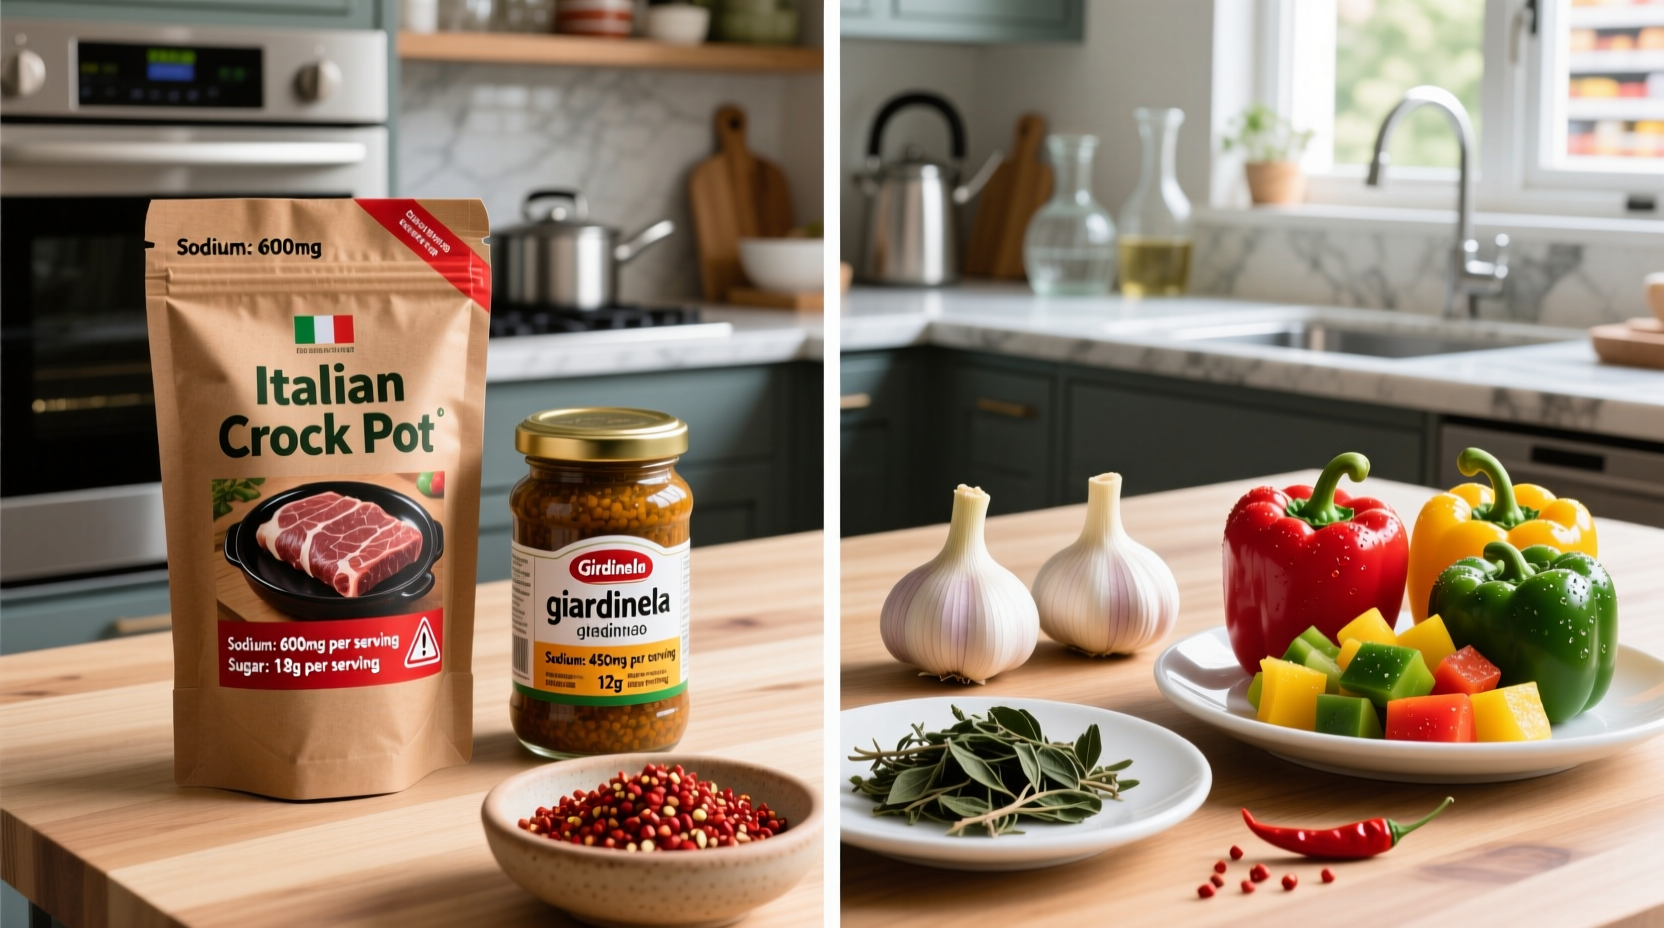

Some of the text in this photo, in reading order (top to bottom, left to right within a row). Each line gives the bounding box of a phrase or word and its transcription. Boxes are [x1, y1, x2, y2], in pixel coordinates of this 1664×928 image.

[177, 238, 322, 259] Sodium: 600mg
[256, 363, 405, 407] Italian
[218, 413, 352, 458] Crock
[546, 587, 670, 625] giardinela
[227, 631, 400, 654] Sodium: 600mg per serving
[227, 656, 380, 677] Sugar: 18g per serving
[598, 674, 624, 693] 12g
